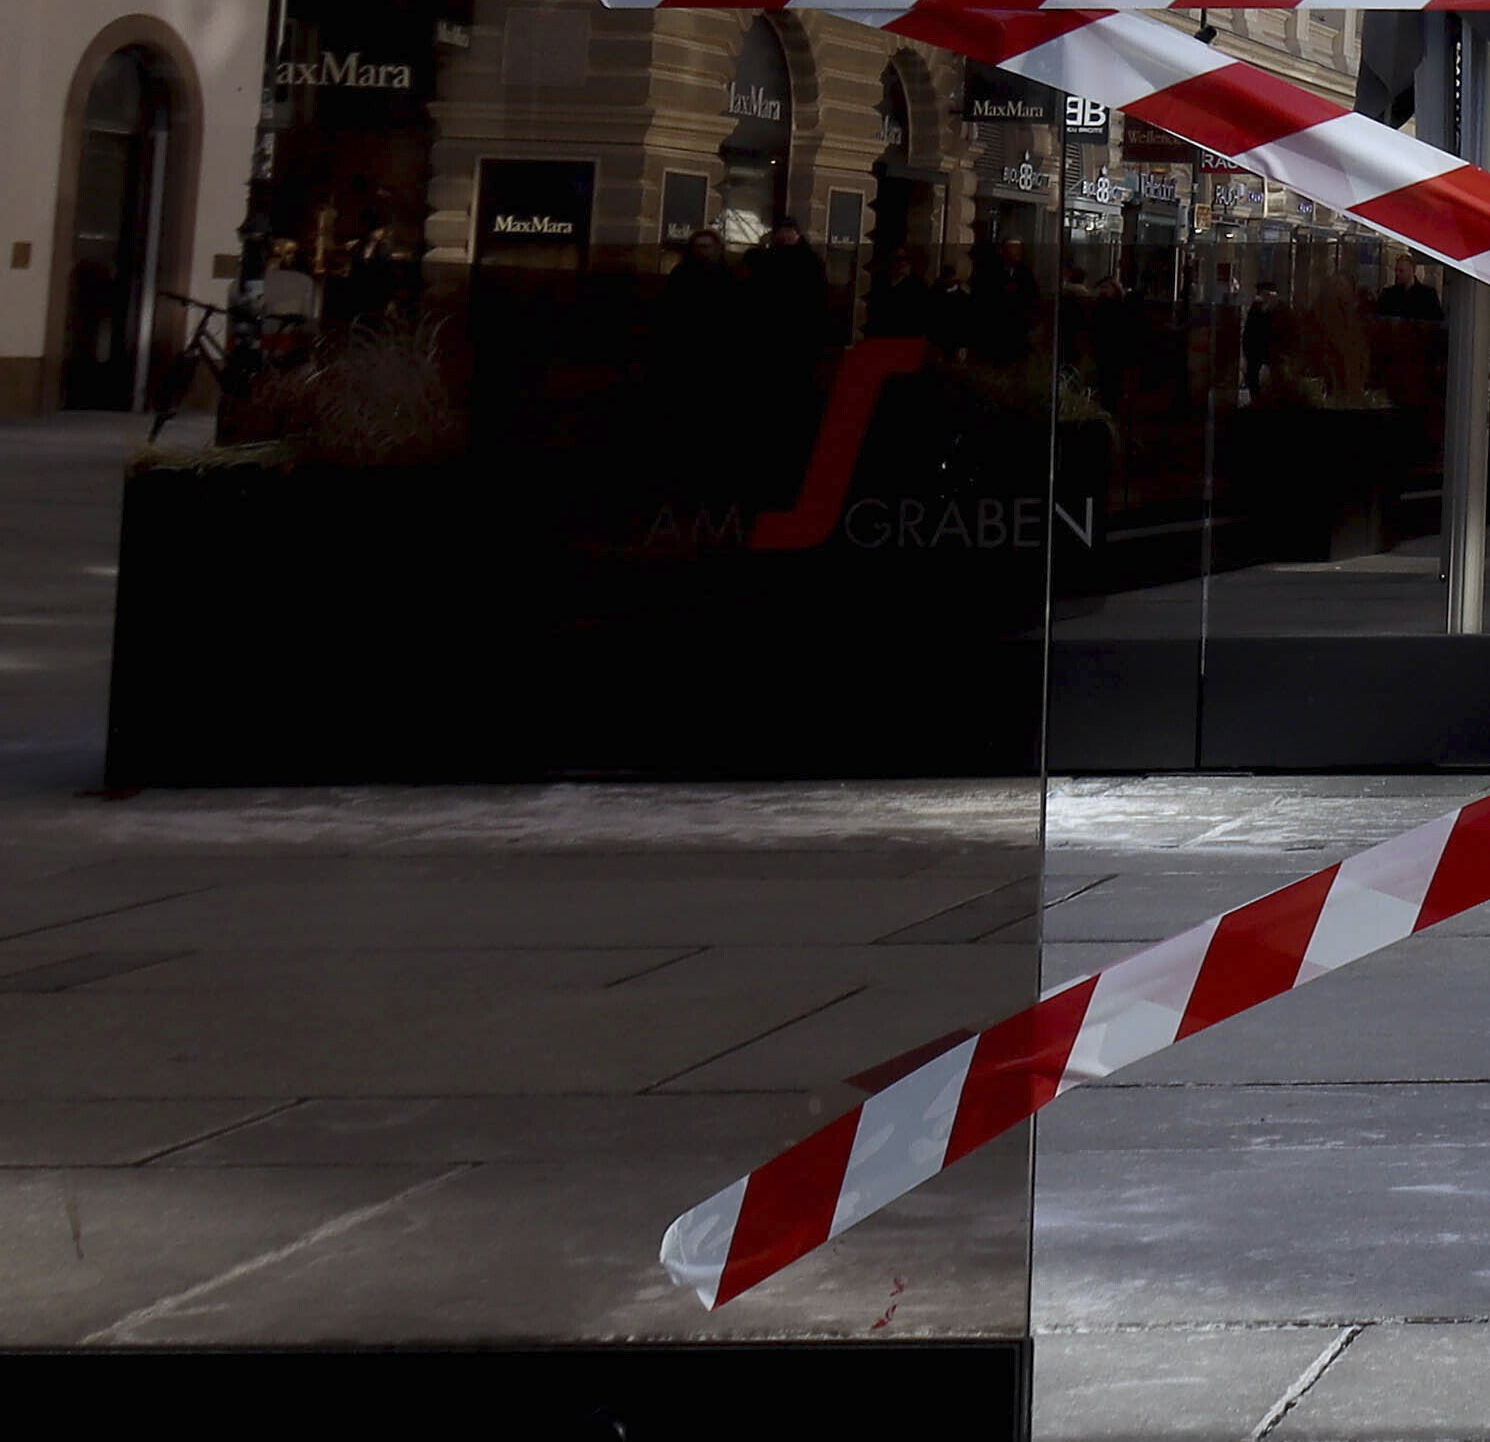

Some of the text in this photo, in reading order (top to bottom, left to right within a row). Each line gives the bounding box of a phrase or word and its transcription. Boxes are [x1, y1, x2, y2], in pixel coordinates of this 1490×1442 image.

[275, 50, 413, 89] axMara
[972, 100, 1044, 118] MaxMara
[493, 214, 573, 235] MaxMara
[843, 496, 1094, 551] GRABEN
